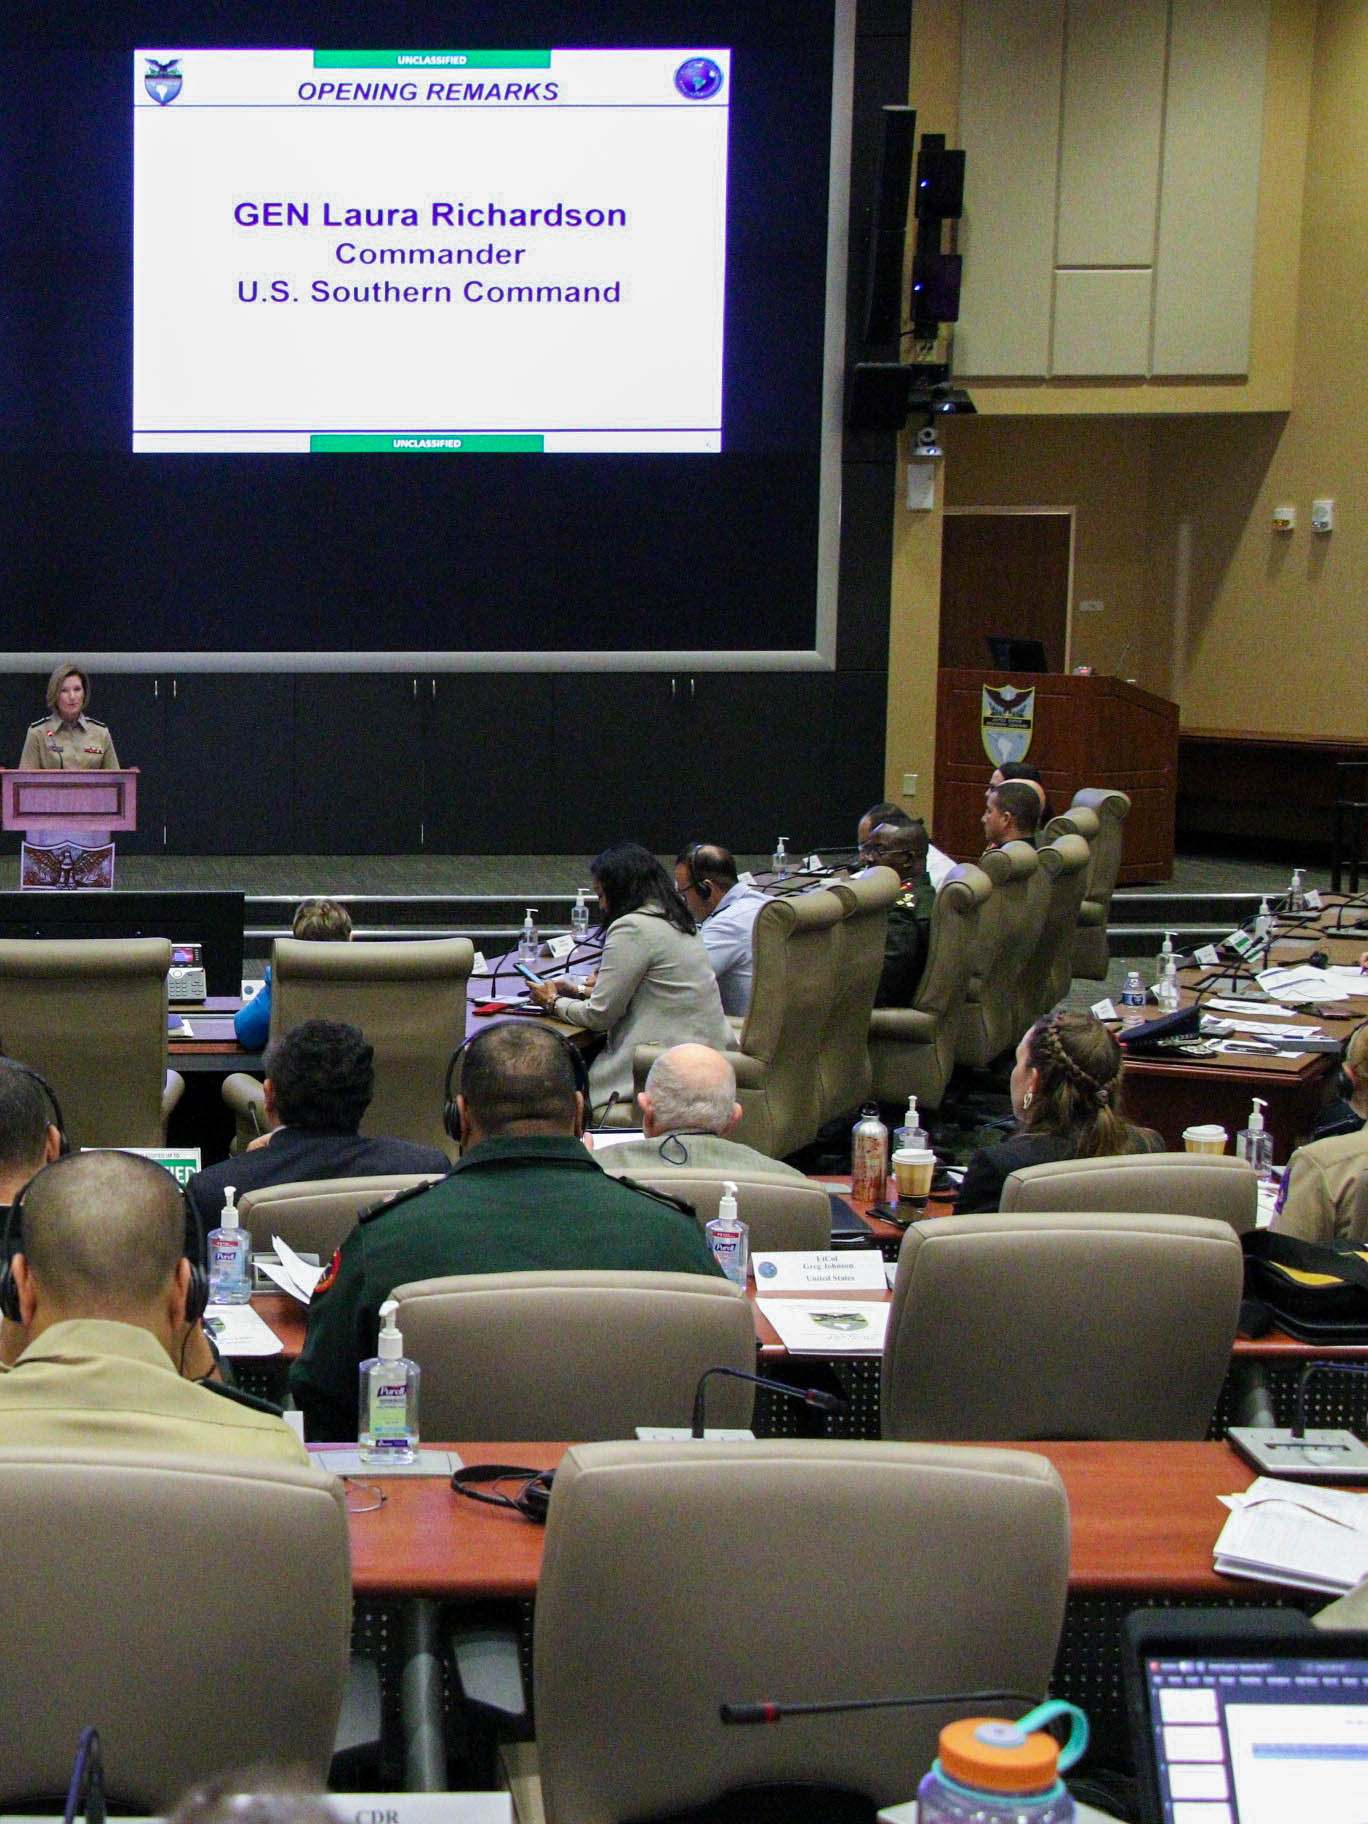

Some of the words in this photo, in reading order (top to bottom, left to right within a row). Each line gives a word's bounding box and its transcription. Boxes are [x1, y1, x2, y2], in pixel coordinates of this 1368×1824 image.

[397, 55, 467, 66] UNCLASSIFIED
[297, 82, 417, 102] OPENING
[426, 82, 559, 101] REMARKS
[234, 203, 309, 227] GEN
[323, 202, 419, 227] Laura
[431, 202, 627, 227] Richardson
[335, 243, 526, 265] Commander
[238, 280, 298, 303] U.S.
[311, 280, 451, 303] Southern
[463, 280, 620, 303] Command
[392, 439, 462, 449] UNCLASSIFIED
[355, 1808, 399, 1824] CDR
